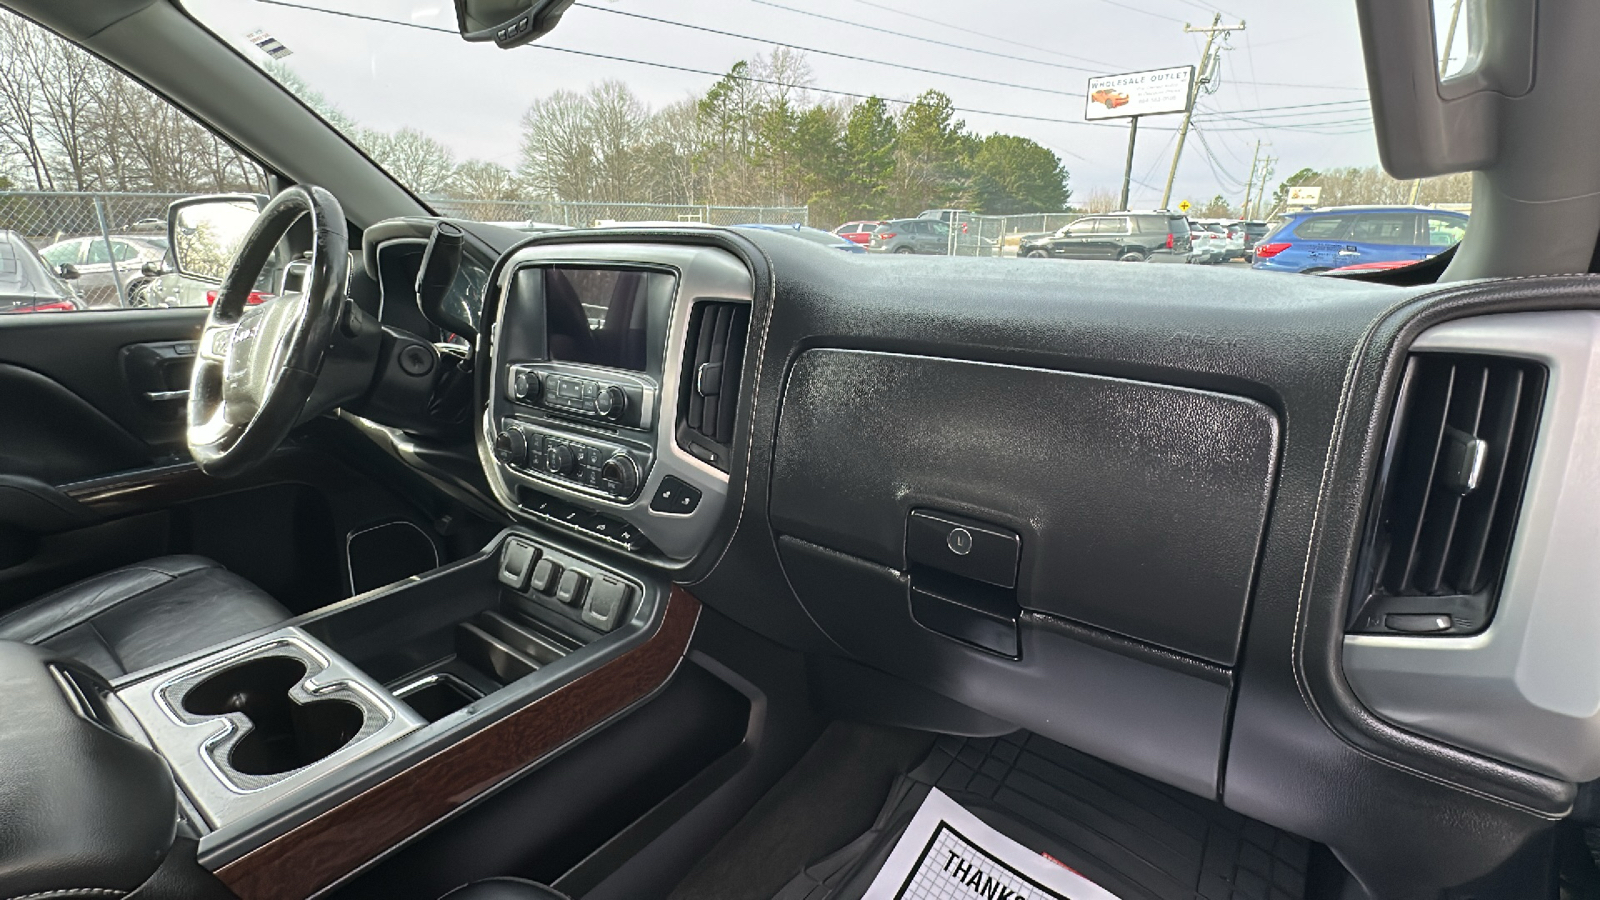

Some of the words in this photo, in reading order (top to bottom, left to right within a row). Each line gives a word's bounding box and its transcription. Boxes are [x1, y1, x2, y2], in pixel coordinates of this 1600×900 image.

[1091, 76, 1145, 89] WHOLESALE
[1150, 71, 1188, 82] OUTLET
[943, 849, 1026, 900] THANK
